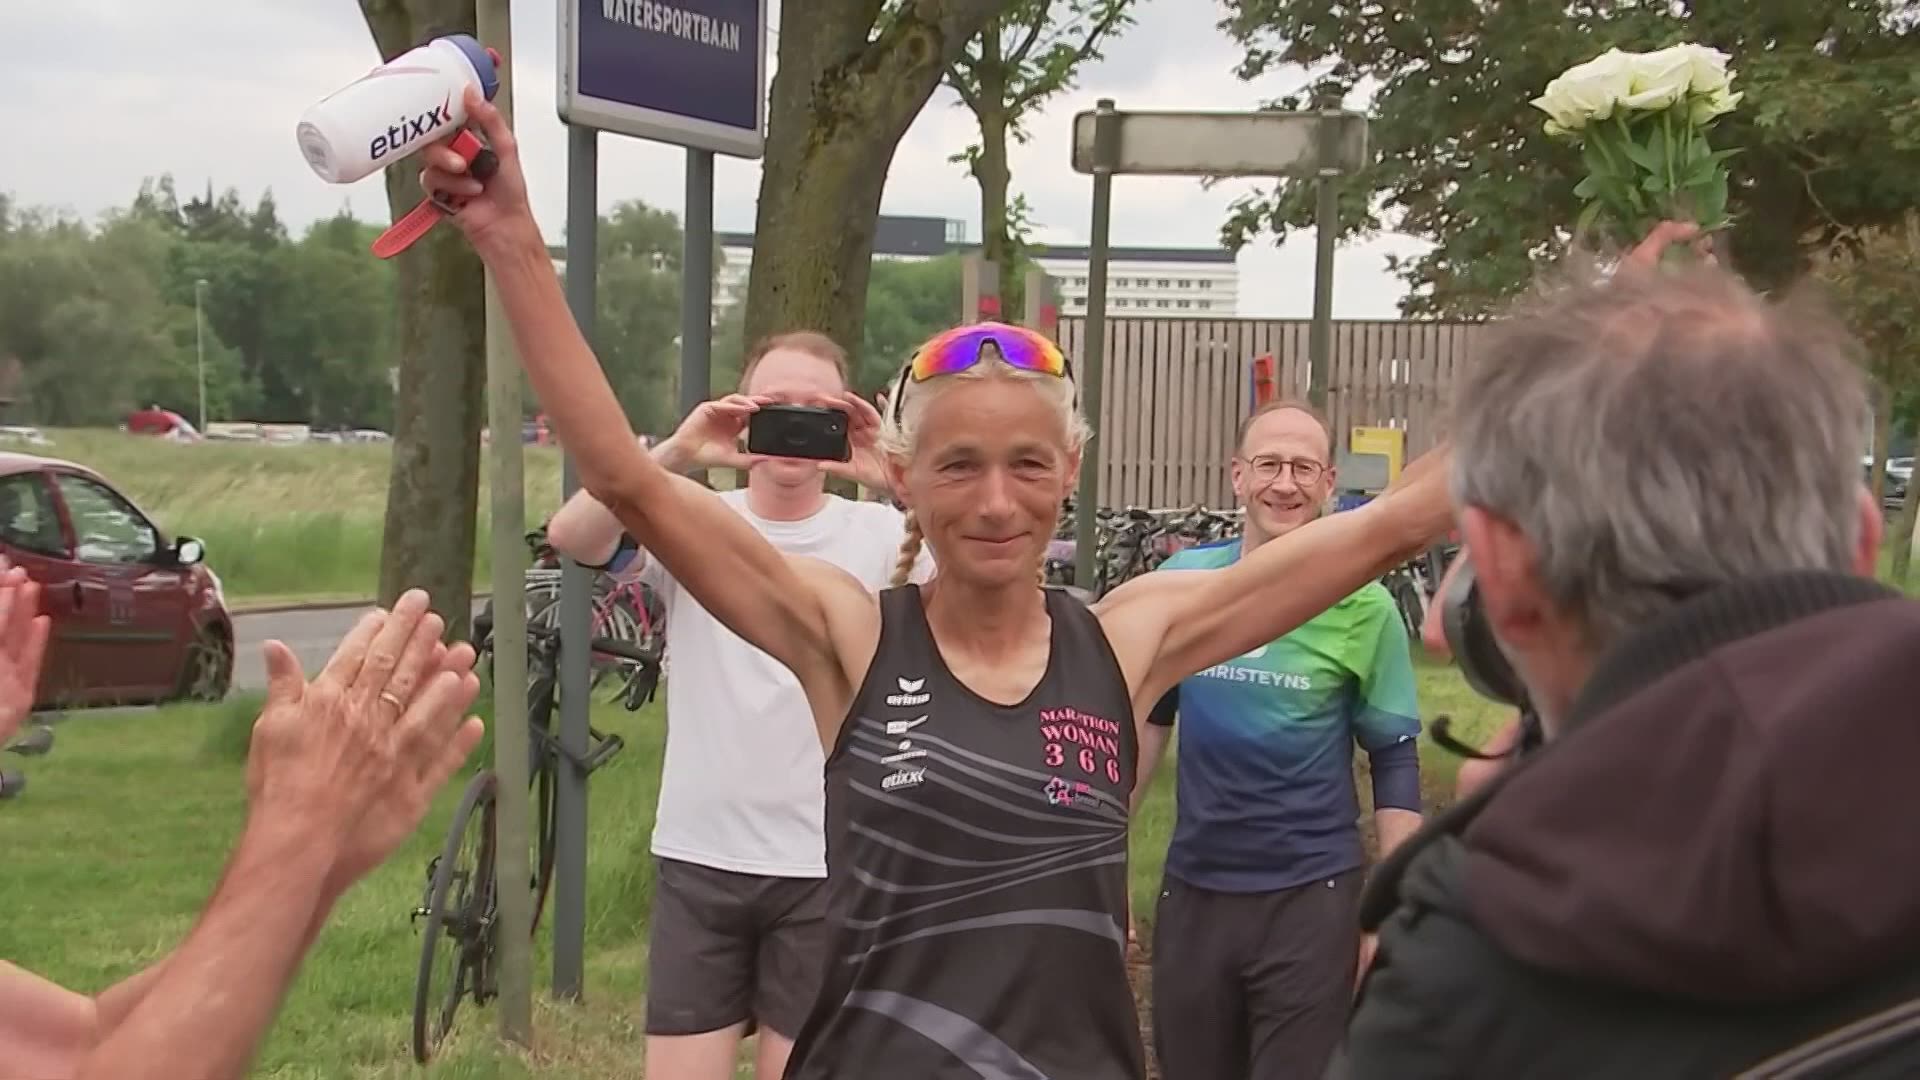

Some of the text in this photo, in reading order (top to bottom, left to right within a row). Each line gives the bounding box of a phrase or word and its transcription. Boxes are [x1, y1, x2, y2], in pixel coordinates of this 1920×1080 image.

[602, 0, 740, 51] WATERSPORTBAAN
[370, 105, 443, 160] etixx
[1194, 664, 1311, 690] HRISTEYNS
[1040, 708, 1120, 735] MARTHON
[1041, 724, 1119, 757] WOMAN
